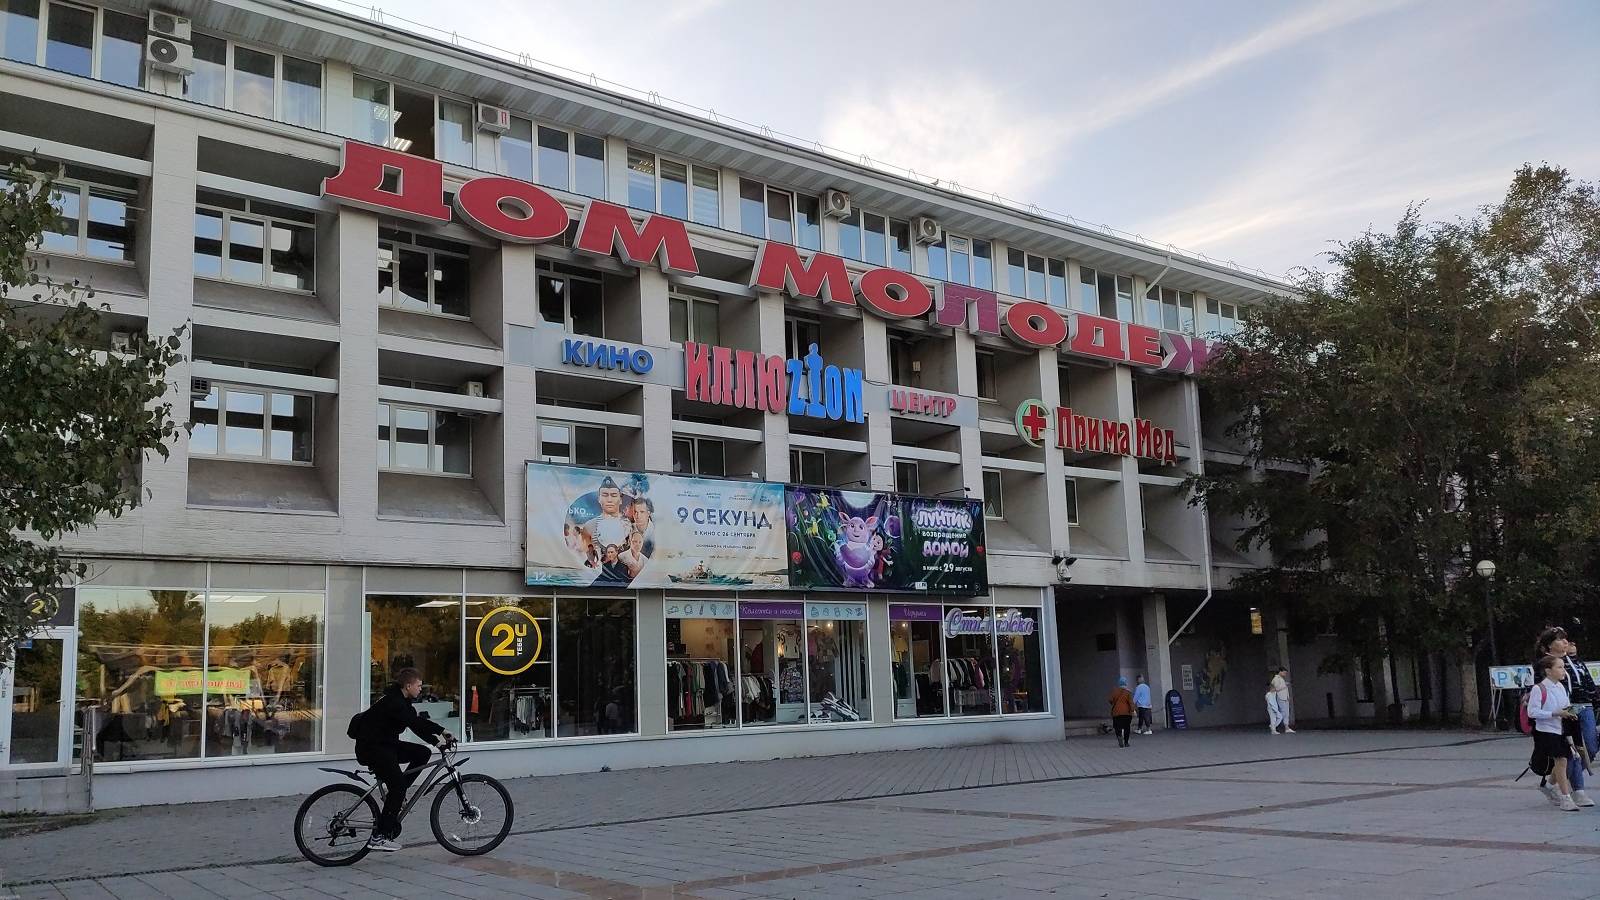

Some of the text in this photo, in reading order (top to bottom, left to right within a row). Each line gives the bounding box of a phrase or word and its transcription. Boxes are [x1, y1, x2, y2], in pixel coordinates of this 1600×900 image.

[320, 140, 699, 277] ДОМ
[561, 337, 654, 376] КИНО
[888, 388, 957, 417] ЦЕНТР
[677, 506, 773, 530] 9 СЕКУНД
[917, 509, 972, 530] ЛУНТИК
[922, 540, 969, 558] ДОМОЙ
[943, 563, 954, 573] 29
